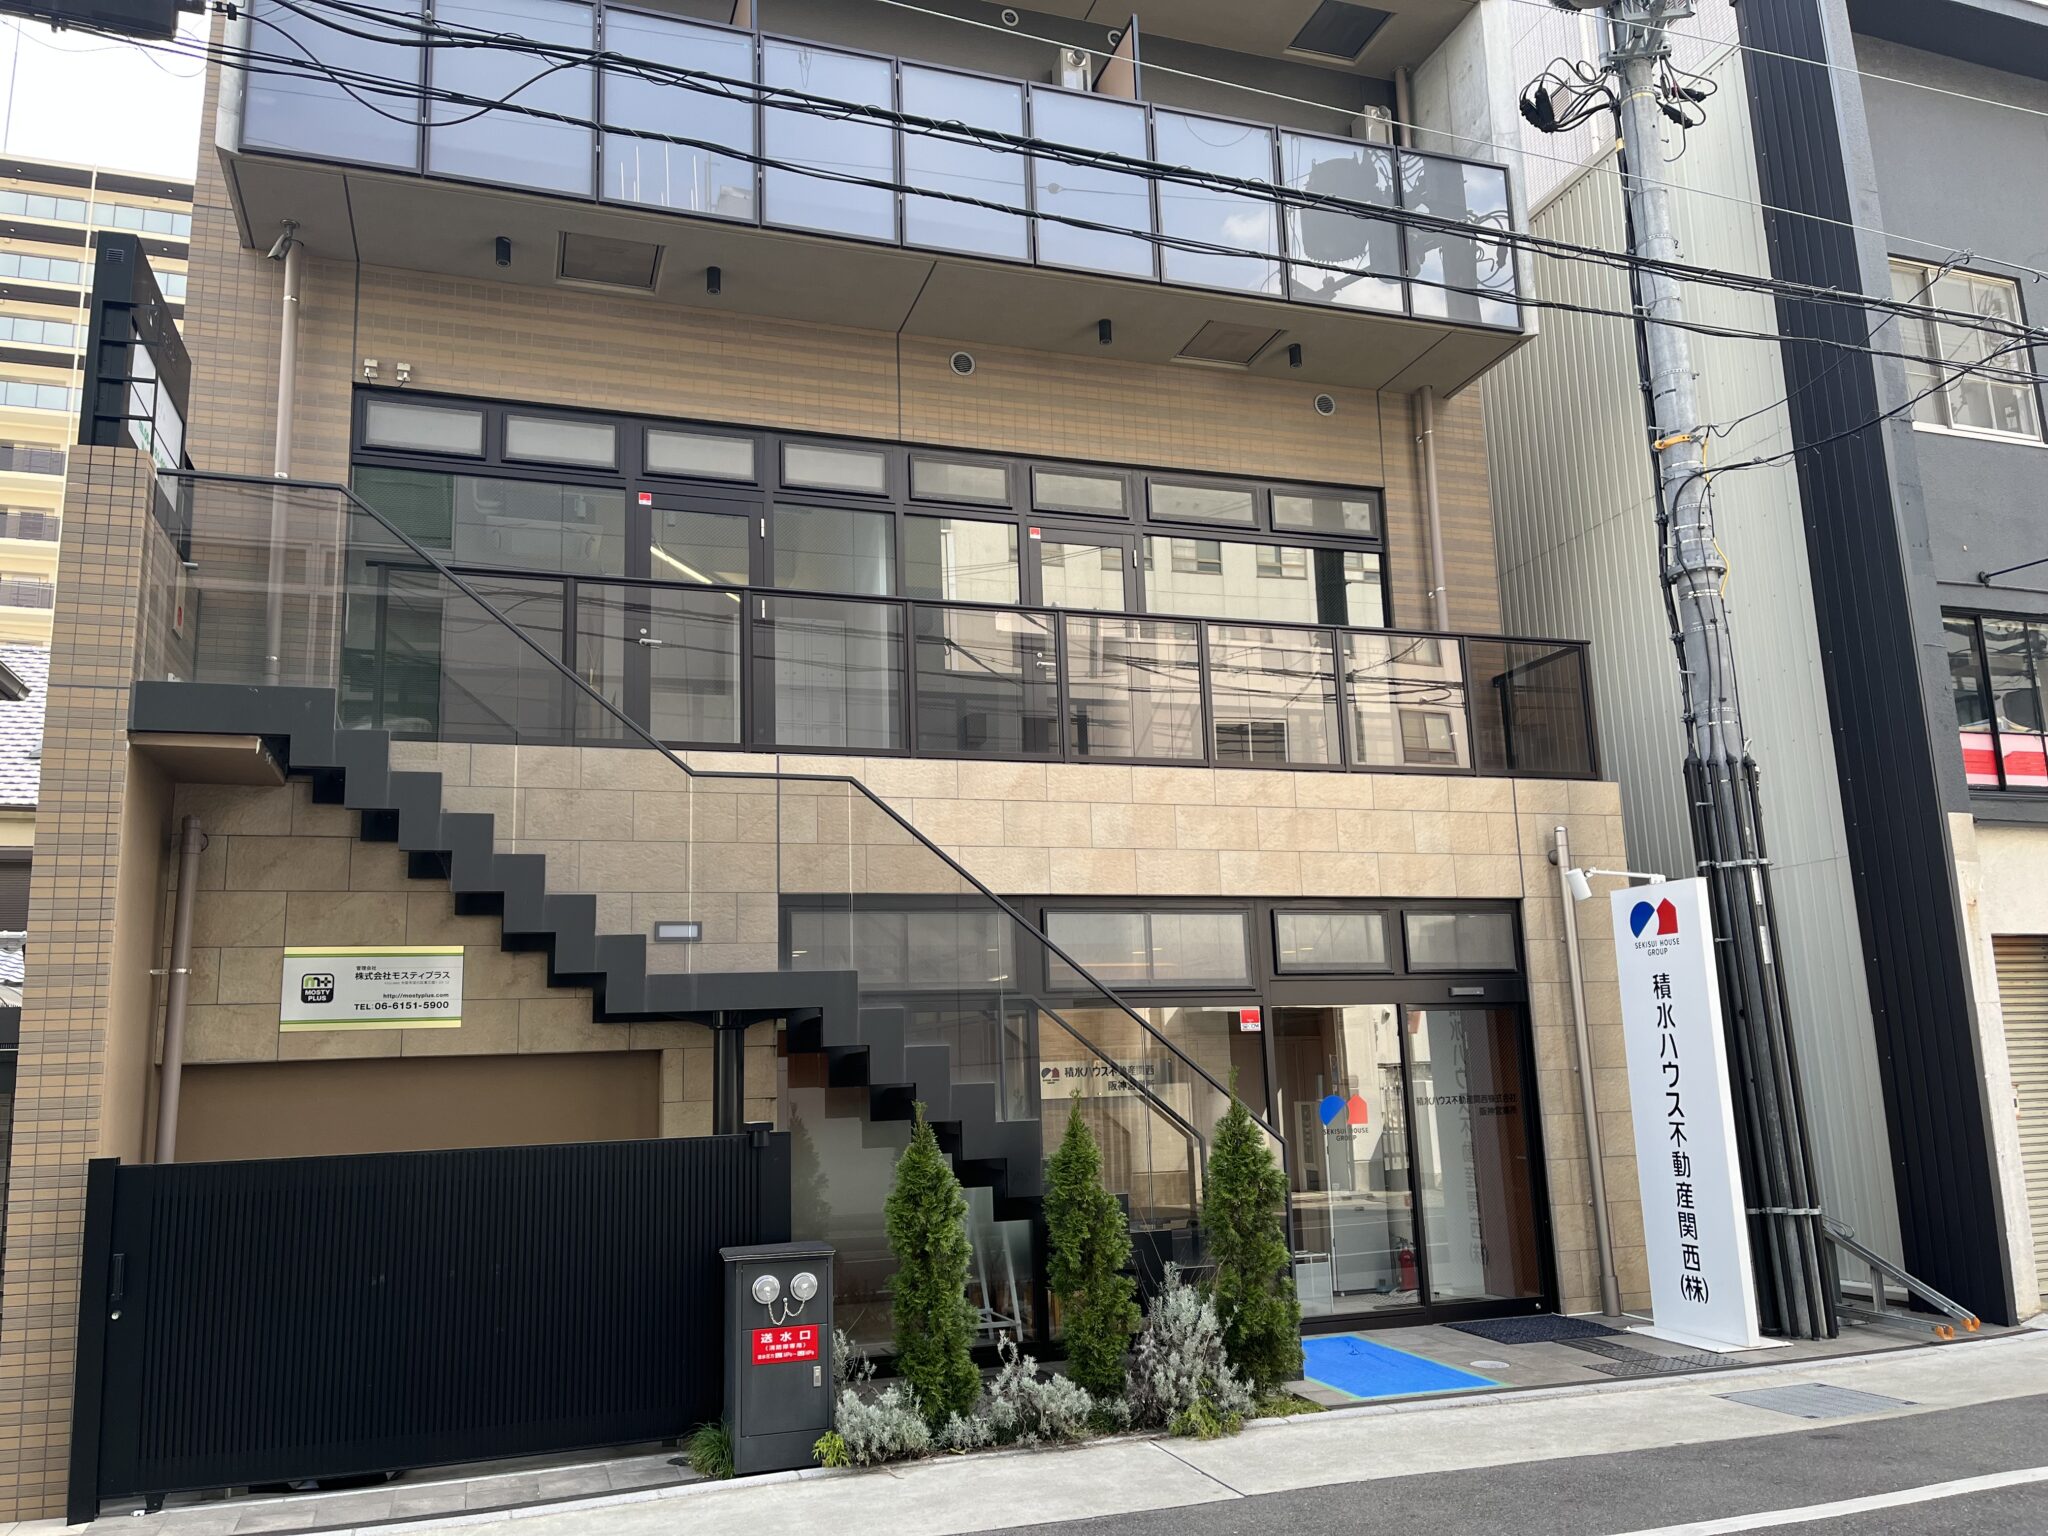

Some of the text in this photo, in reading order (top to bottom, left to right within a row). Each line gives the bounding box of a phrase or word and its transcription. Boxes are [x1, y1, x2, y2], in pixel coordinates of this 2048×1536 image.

[1634, 937, 1680, 950] SEKISUI HOUSE
[1647, 949, 1668, 957] GROUP
[1335, 1134, 1357, 1142] GROUP
[760, 1330, 811, 1344] 送水口
